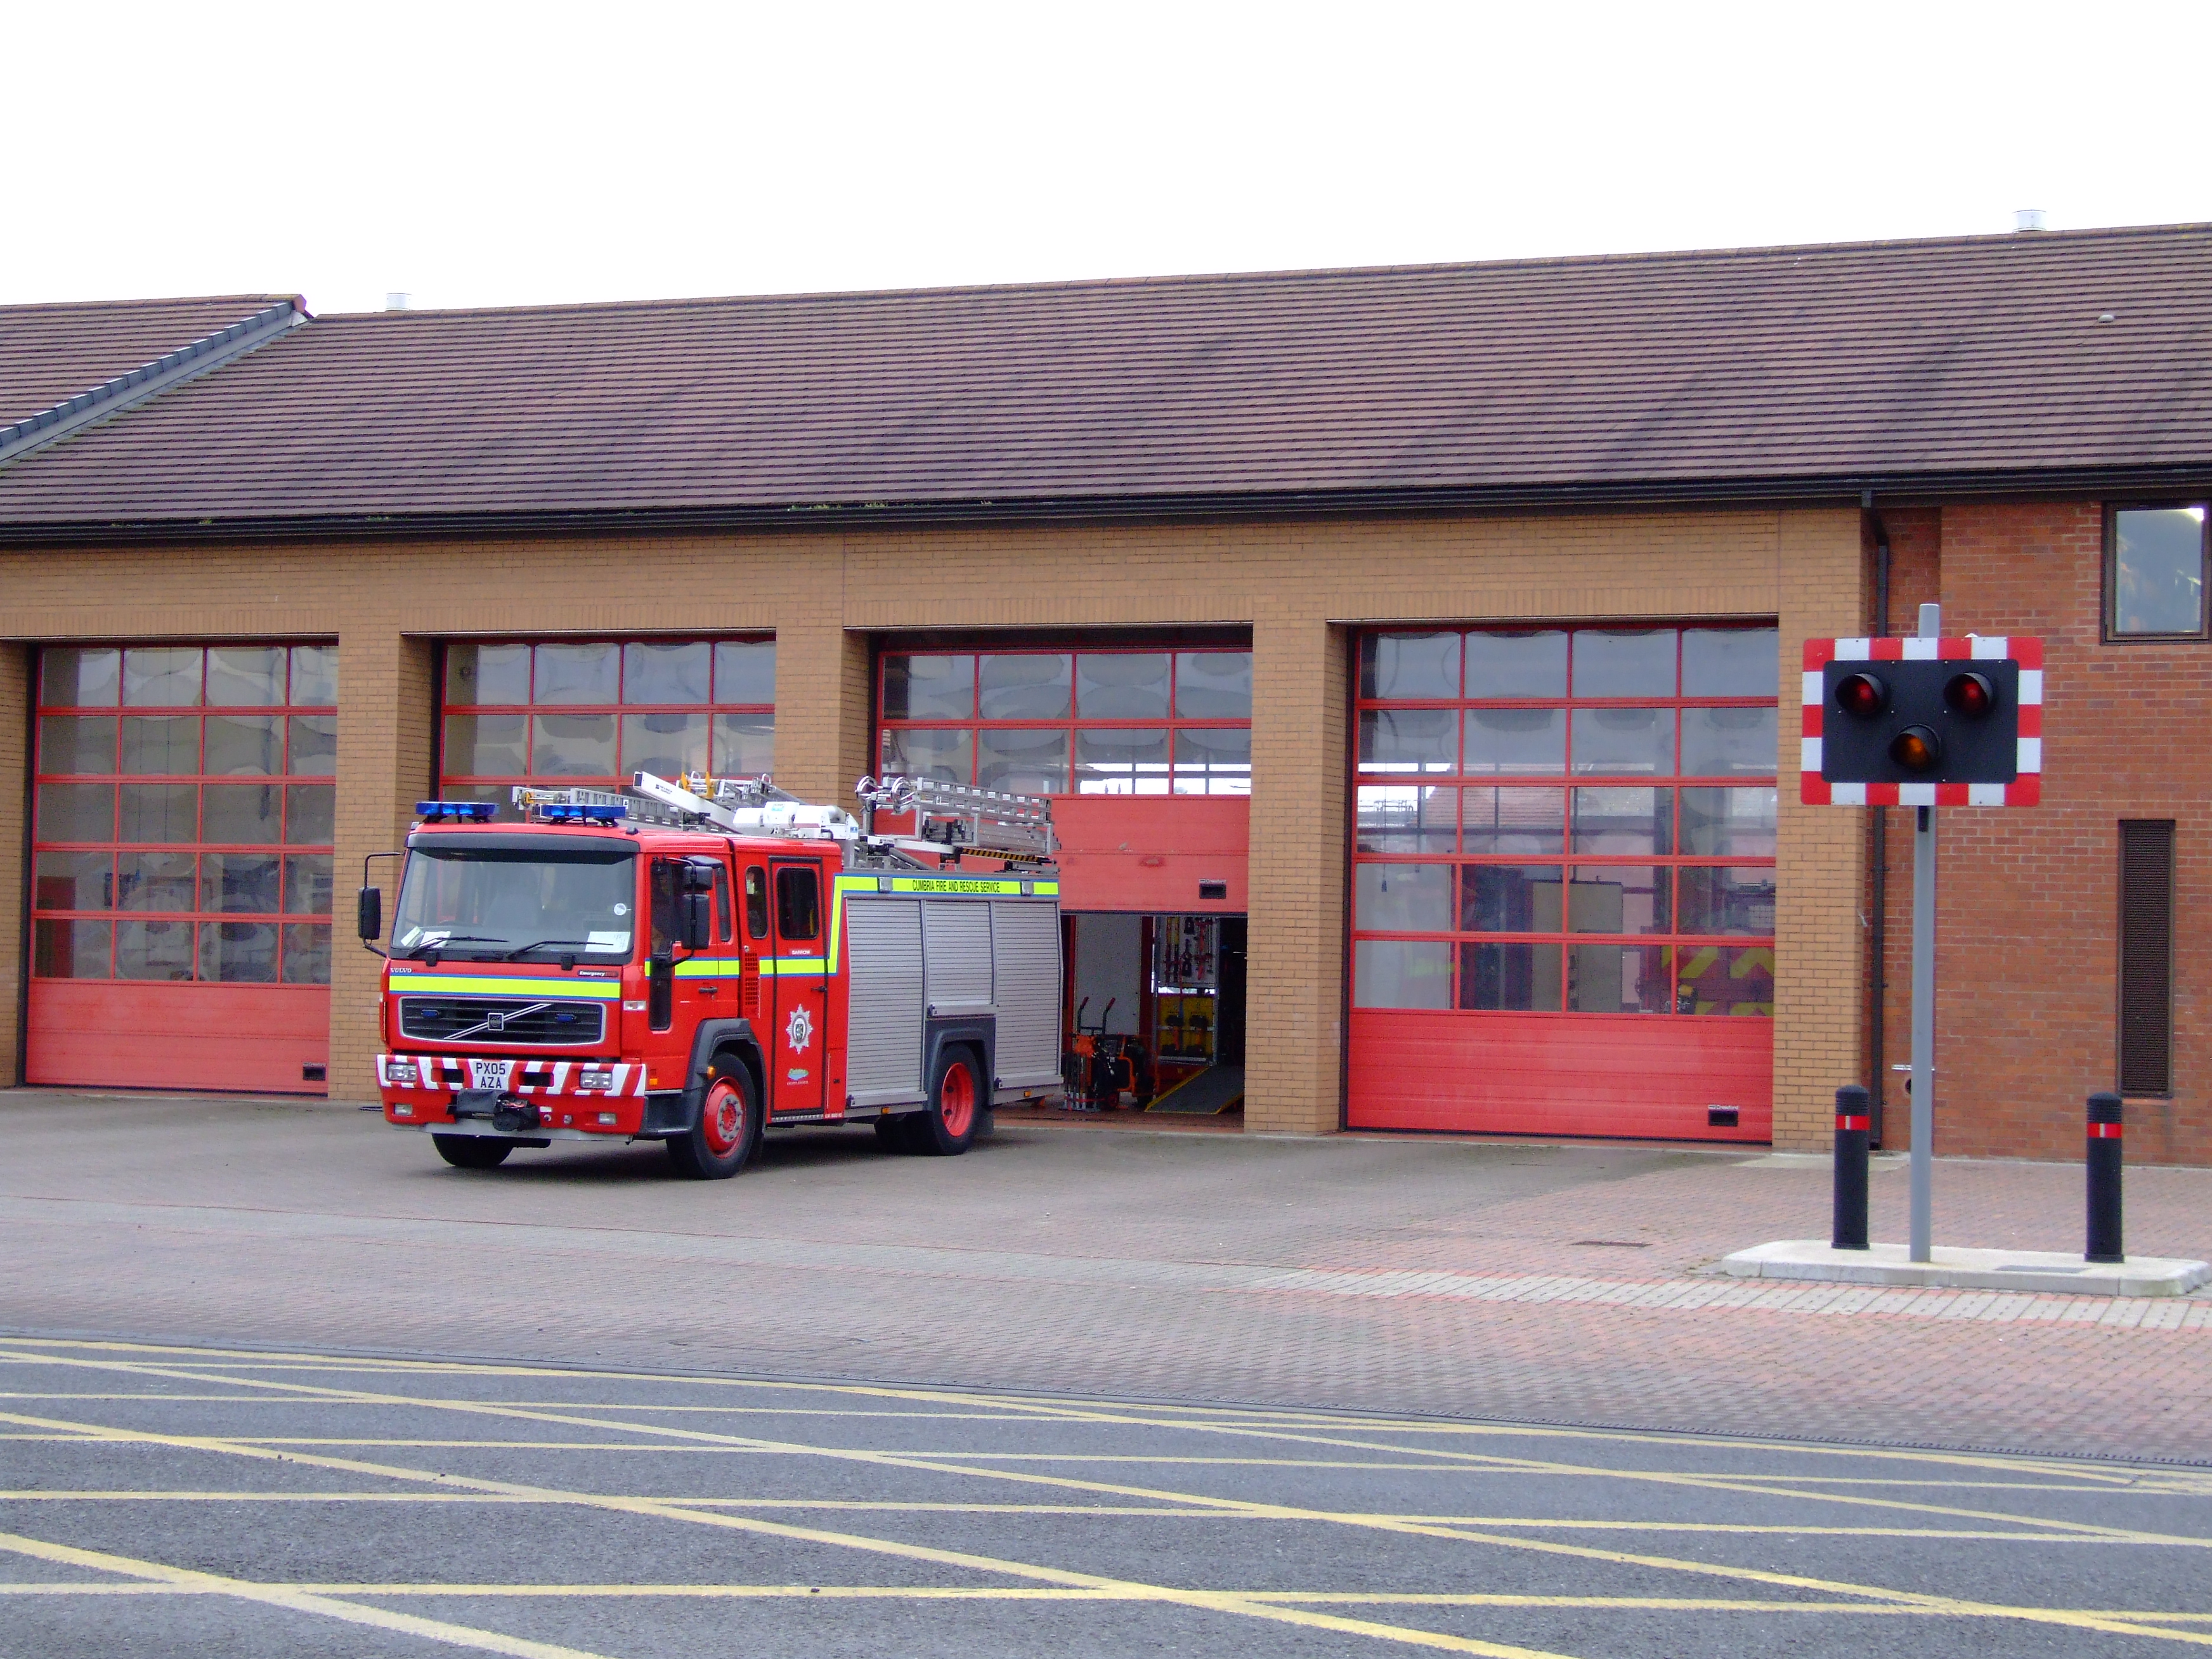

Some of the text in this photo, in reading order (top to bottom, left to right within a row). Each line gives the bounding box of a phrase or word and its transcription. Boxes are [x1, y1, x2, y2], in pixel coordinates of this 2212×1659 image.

[912, 879, 1000, 893] CUMBRIA FIRE AND RESCUE SERVICE
[476, 1062, 505, 1075] PX05
[480, 1076, 502, 1089] AZA
